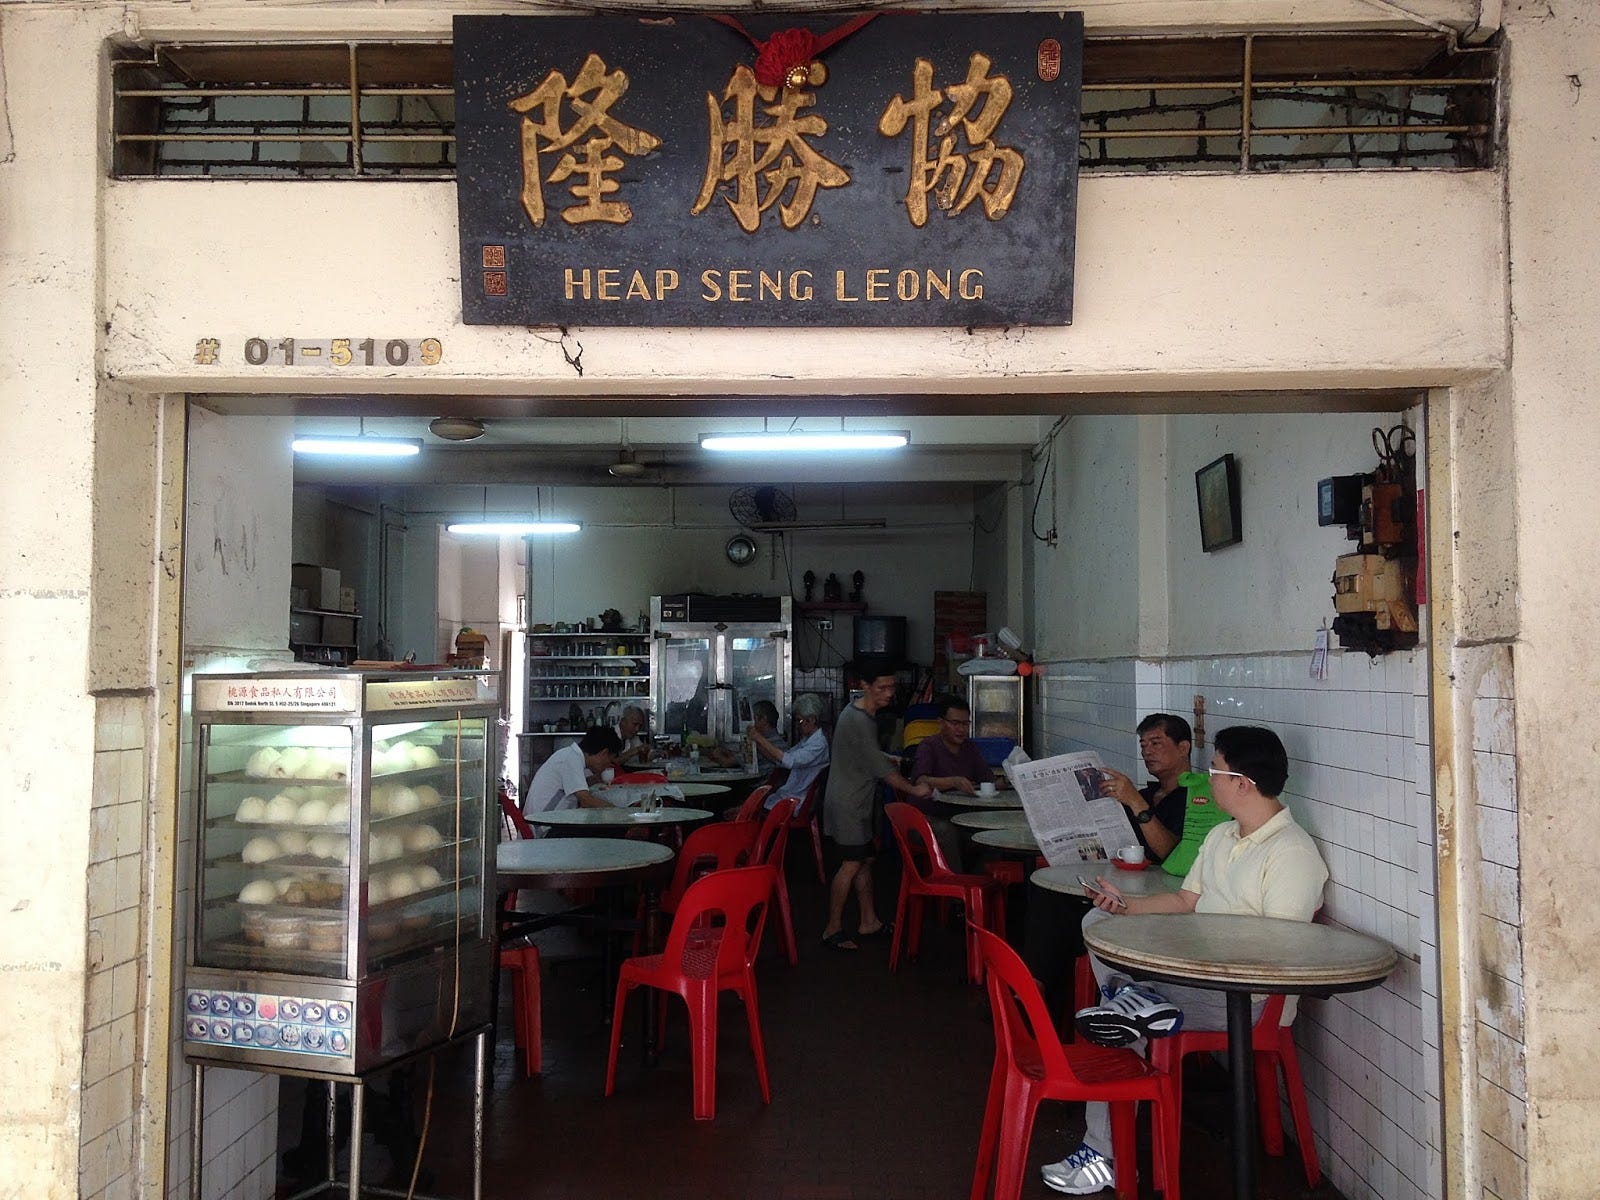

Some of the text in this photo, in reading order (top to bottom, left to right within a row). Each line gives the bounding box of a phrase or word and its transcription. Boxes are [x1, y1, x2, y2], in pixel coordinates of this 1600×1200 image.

[564, 268, 984, 302] HEAP SENG LEONG
[228, 686, 336, 699] 桃源食品私人有限公司
[301, 700, 320, 708] Singapore
